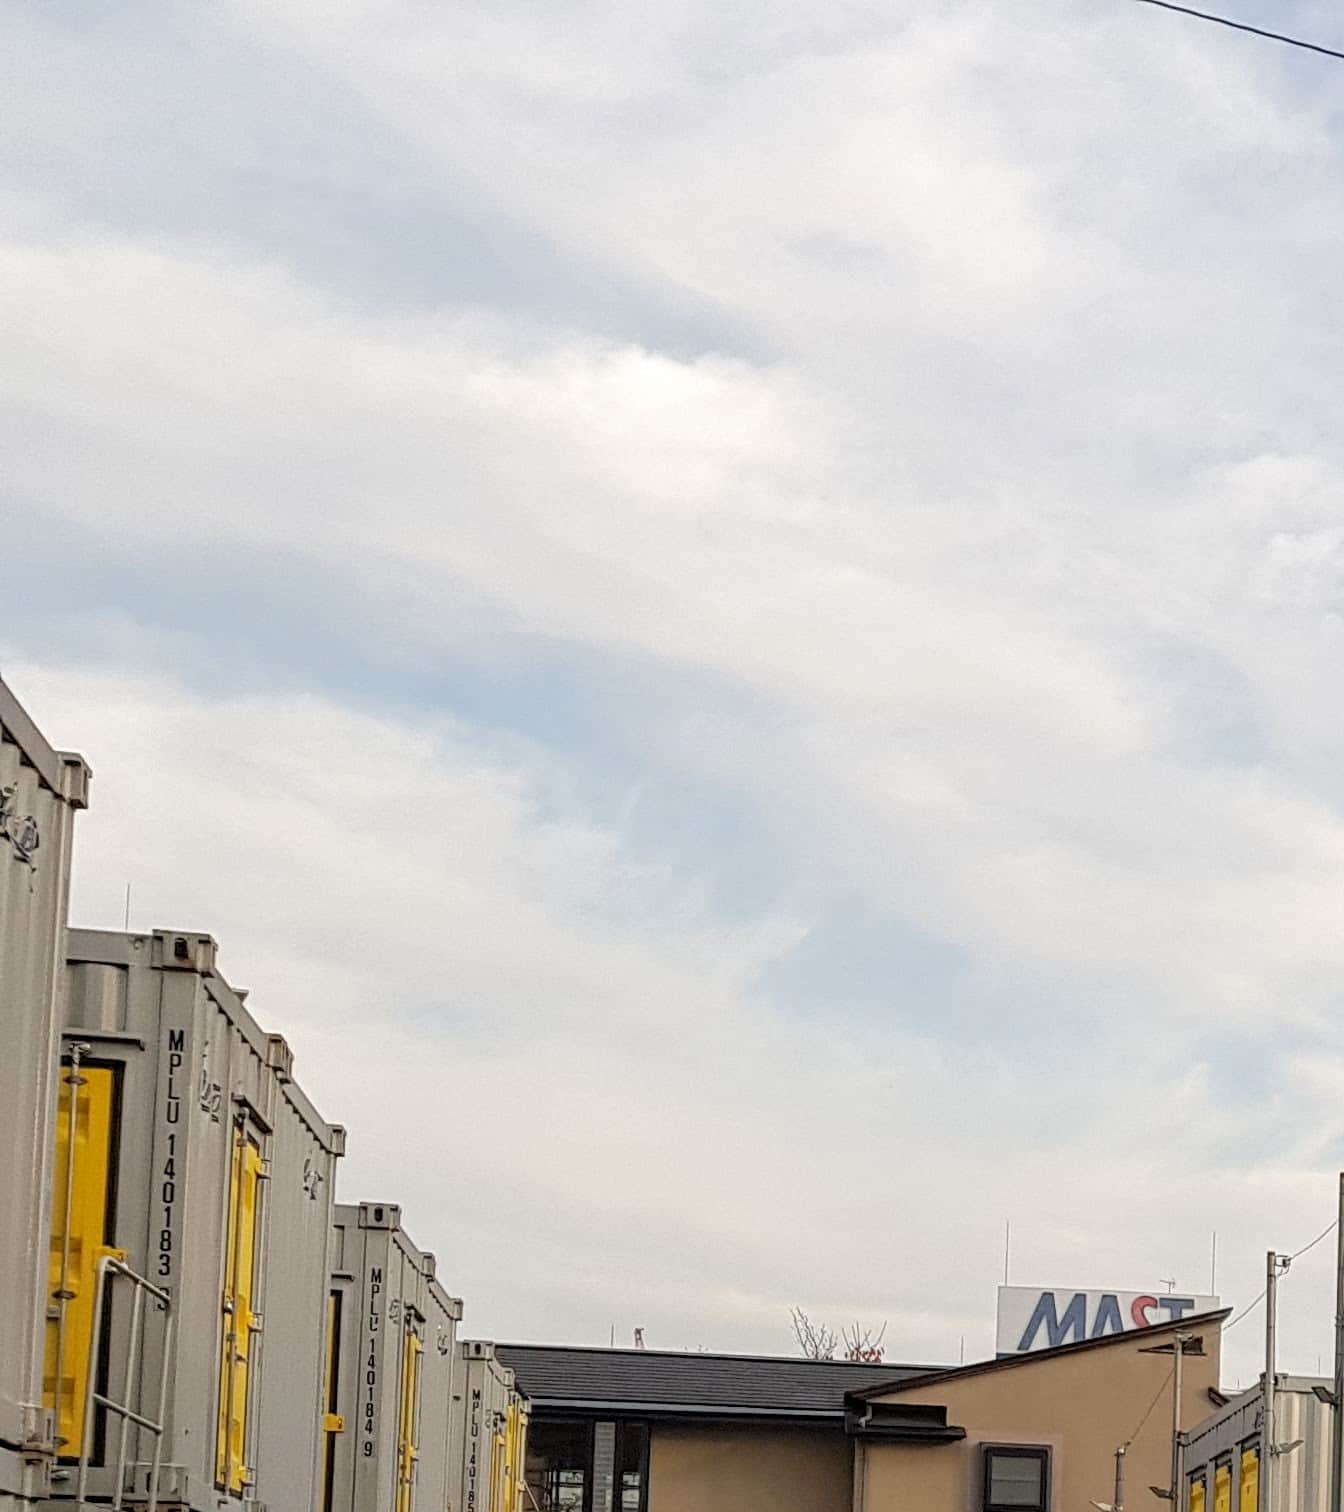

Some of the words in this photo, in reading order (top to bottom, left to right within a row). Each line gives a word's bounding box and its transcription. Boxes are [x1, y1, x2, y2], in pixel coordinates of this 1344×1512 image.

[168, 1030, 185, 1124] MPLU
[158, 1134, 176, 1276] 140183
[369, 1268, 382, 1332] MPLU
[364, 1338, 376, 1434] 140184
